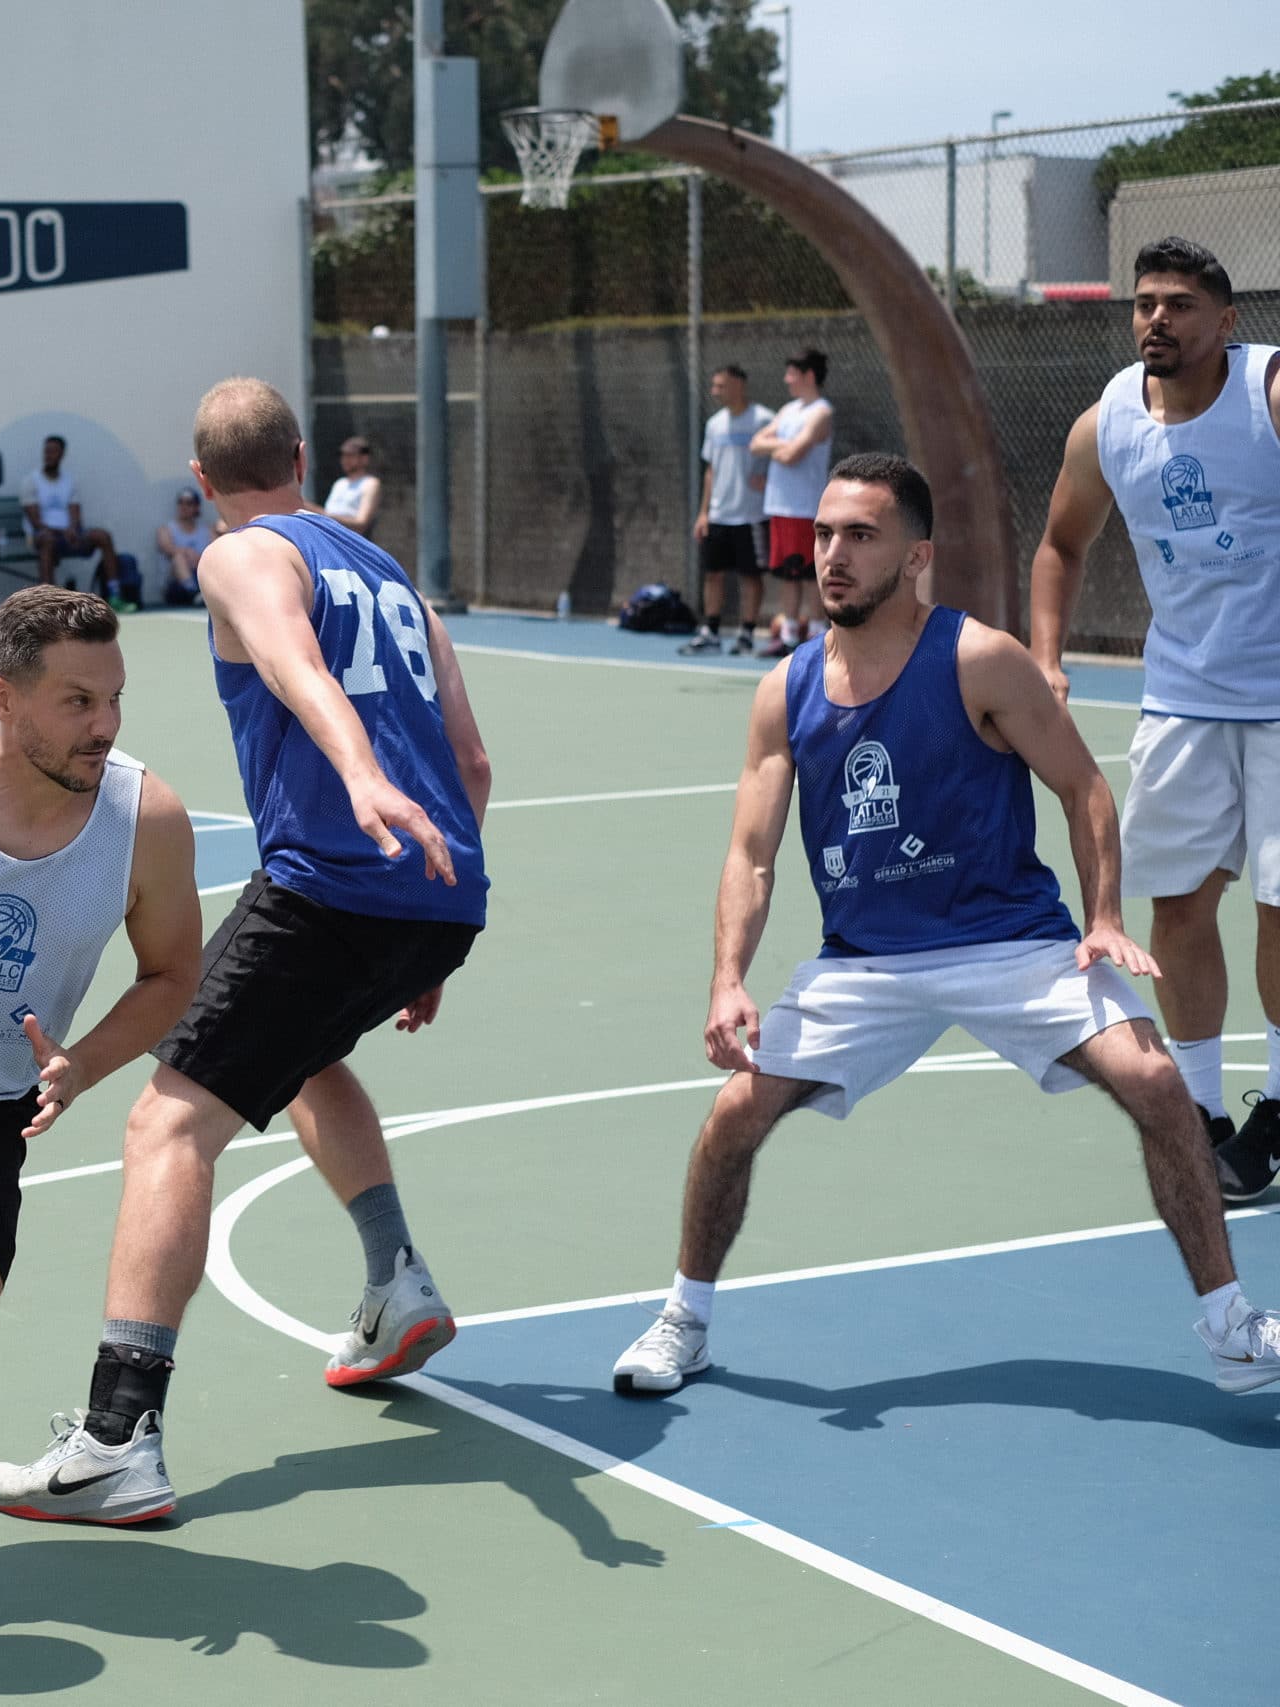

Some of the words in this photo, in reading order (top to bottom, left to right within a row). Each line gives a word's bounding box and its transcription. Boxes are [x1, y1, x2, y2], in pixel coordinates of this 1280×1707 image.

[1174, 503, 1210, 519] LATLC
[320, 569, 438, 702] 78
[852, 800, 893, 819] LATLC
[874, 867, 906, 880] GERALD
[920, 857, 955, 869] MARCUS
